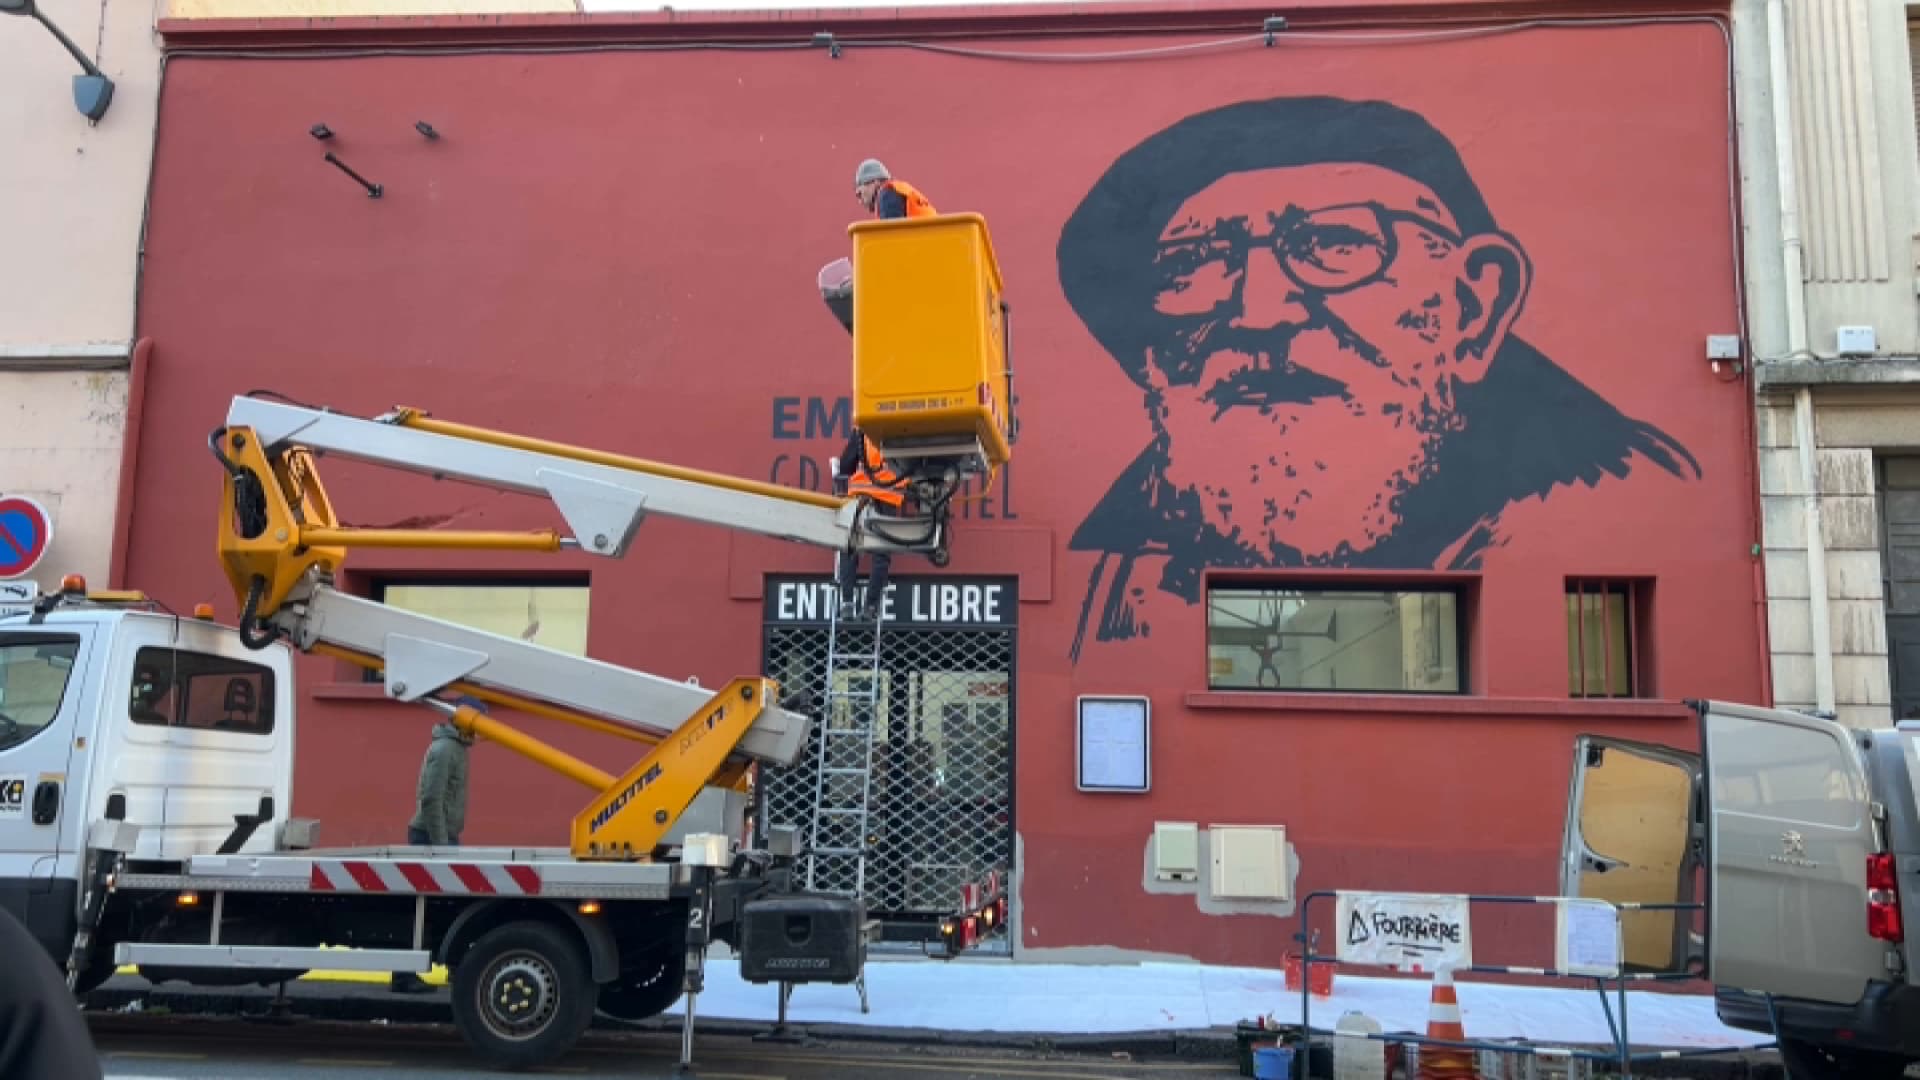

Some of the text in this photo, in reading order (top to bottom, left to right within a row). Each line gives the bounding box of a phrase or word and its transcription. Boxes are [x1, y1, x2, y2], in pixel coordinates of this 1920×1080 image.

[778, 582, 1002, 621] ENTE LIBRE
[590, 761, 664, 834] MULTITEL
[689, 908, 702, 928] 2
